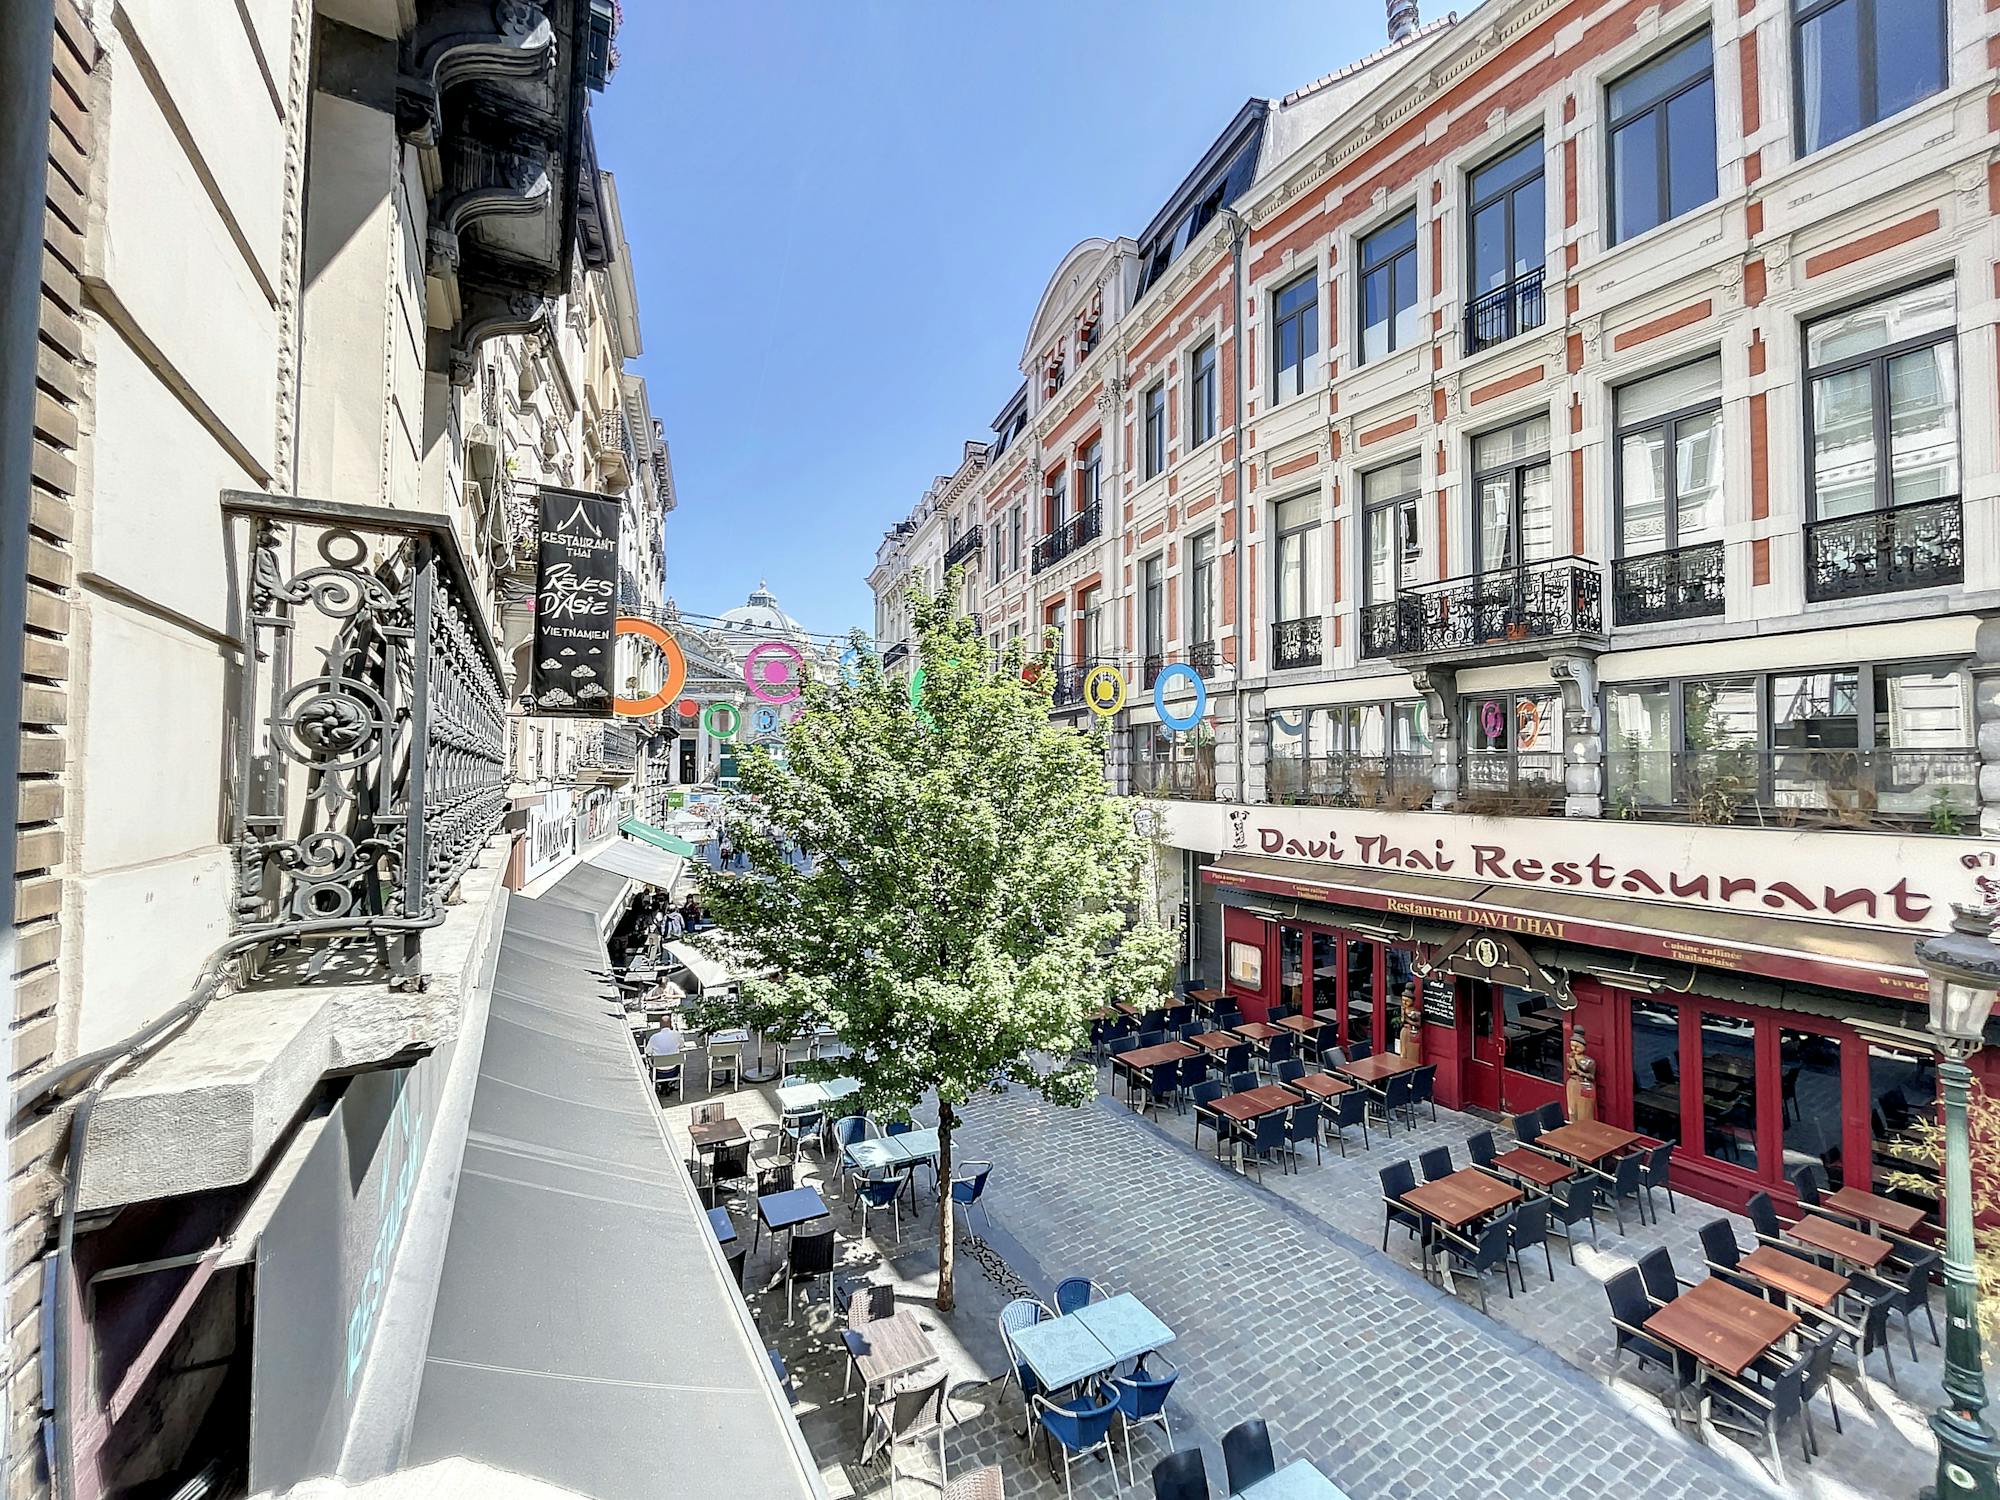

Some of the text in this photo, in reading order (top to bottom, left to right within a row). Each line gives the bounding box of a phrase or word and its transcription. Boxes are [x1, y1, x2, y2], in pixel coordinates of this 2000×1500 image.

[541, 531, 616, 552] RESTAURANT
[566, 547, 592, 558] THAI
[541, 625, 610, 640] VIETNAMIEN
[1257, 828, 1933, 923] Davi Thai Restaurant
[1387, 898, 1565, 938] Restaurant DAVI THAI
[1662, 940, 1700, 954] Cuisine
